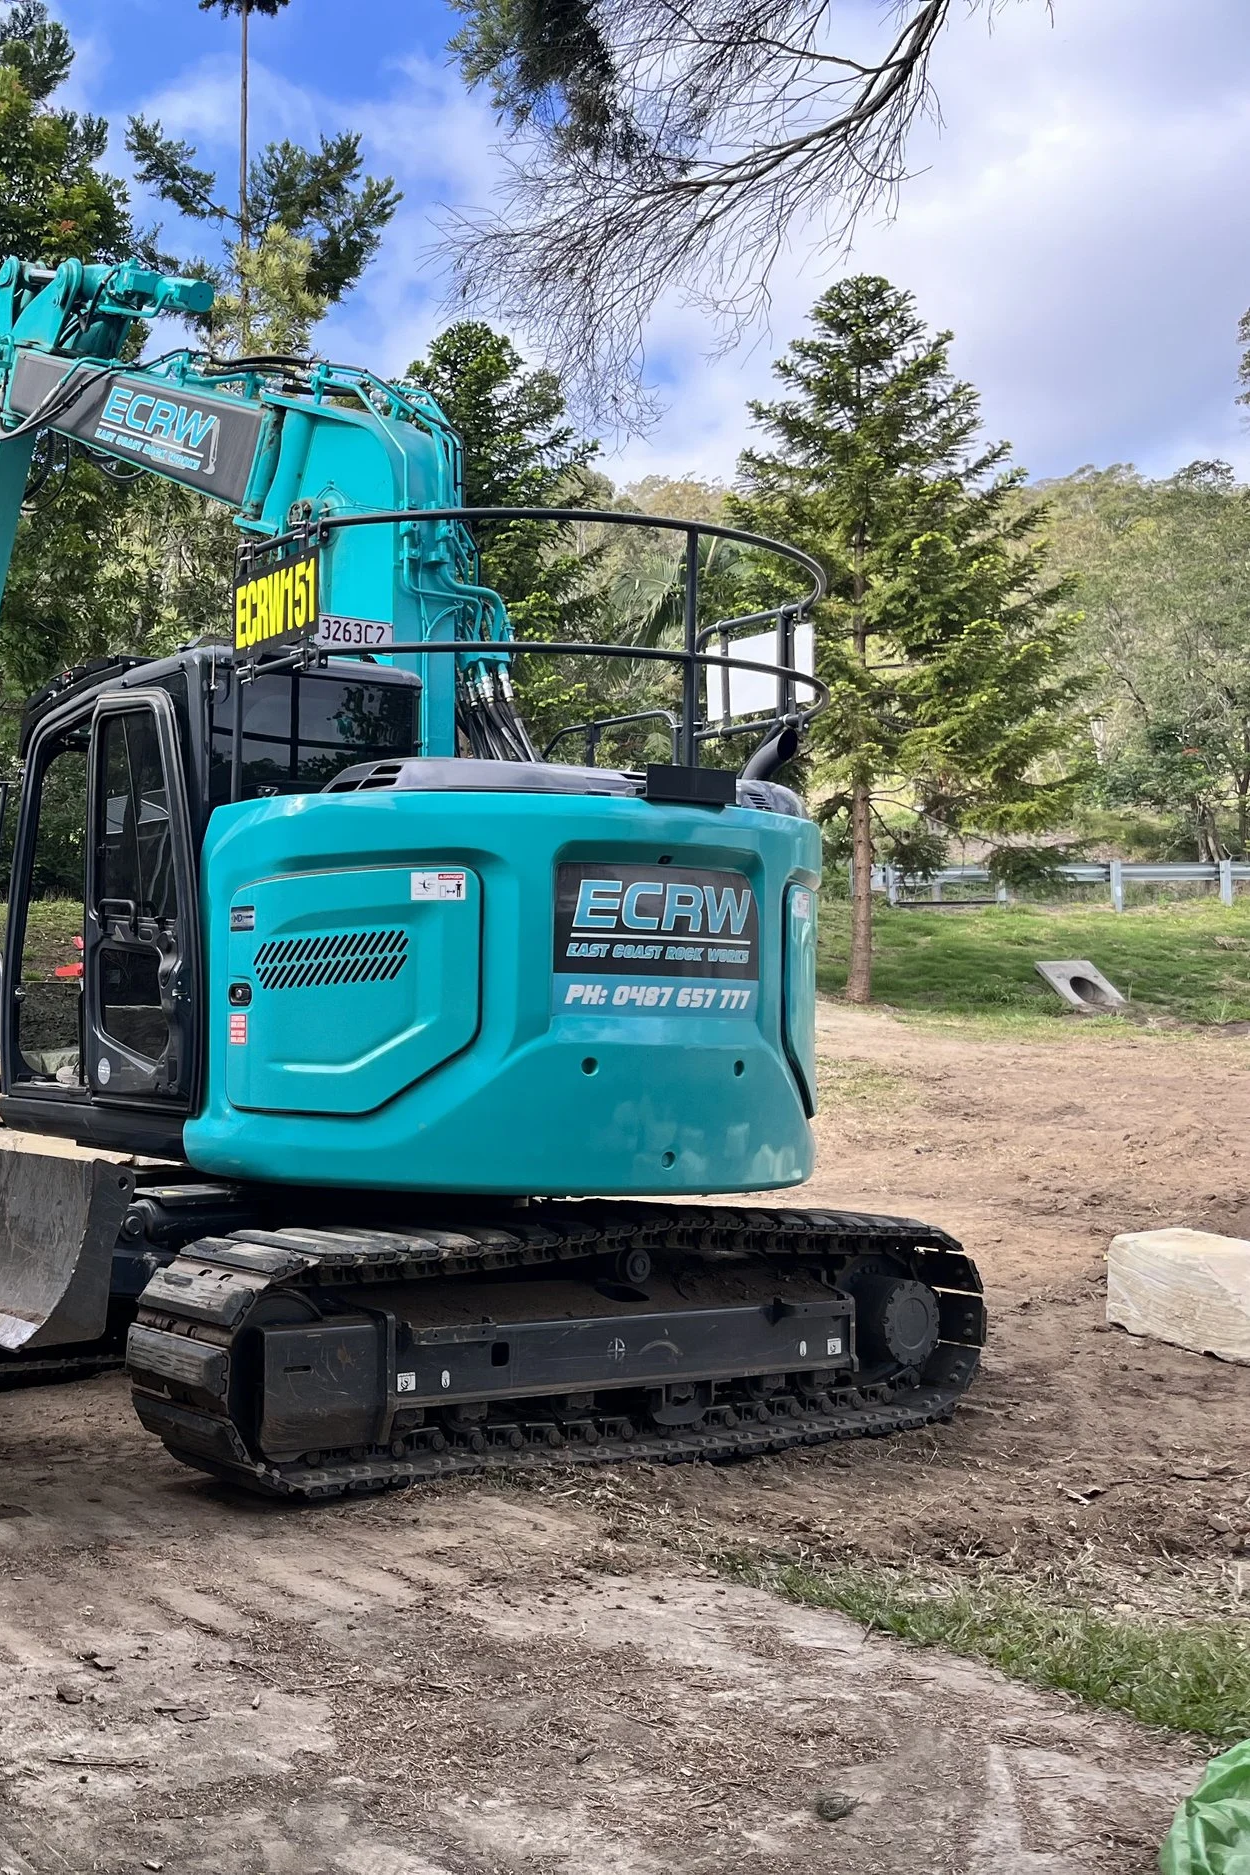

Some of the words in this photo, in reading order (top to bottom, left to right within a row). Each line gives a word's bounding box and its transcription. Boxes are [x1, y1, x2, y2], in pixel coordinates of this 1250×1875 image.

[100, 385, 217, 448] ECRW
[94, 428, 116, 443] EAST
[116, 434, 143, 453] COAST
[143, 442, 166, 459] ROCK
[168, 452, 200, 471] WORKS
[235, 557, 315, 650] ECRW151
[572, 879, 752, 935] ECRW
[566, 942, 610, 958] EAST
[612, 944, 663, 960] COAST
[665, 946, 705, 962] ROCK
[707, 949, 749, 964] WORKS
[564, 984, 608, 1005] PH:
[612, 985, 674, 1007] 0487
[675, 987, 717, 1009] 657
[718, 989, 751, 1010] 777
